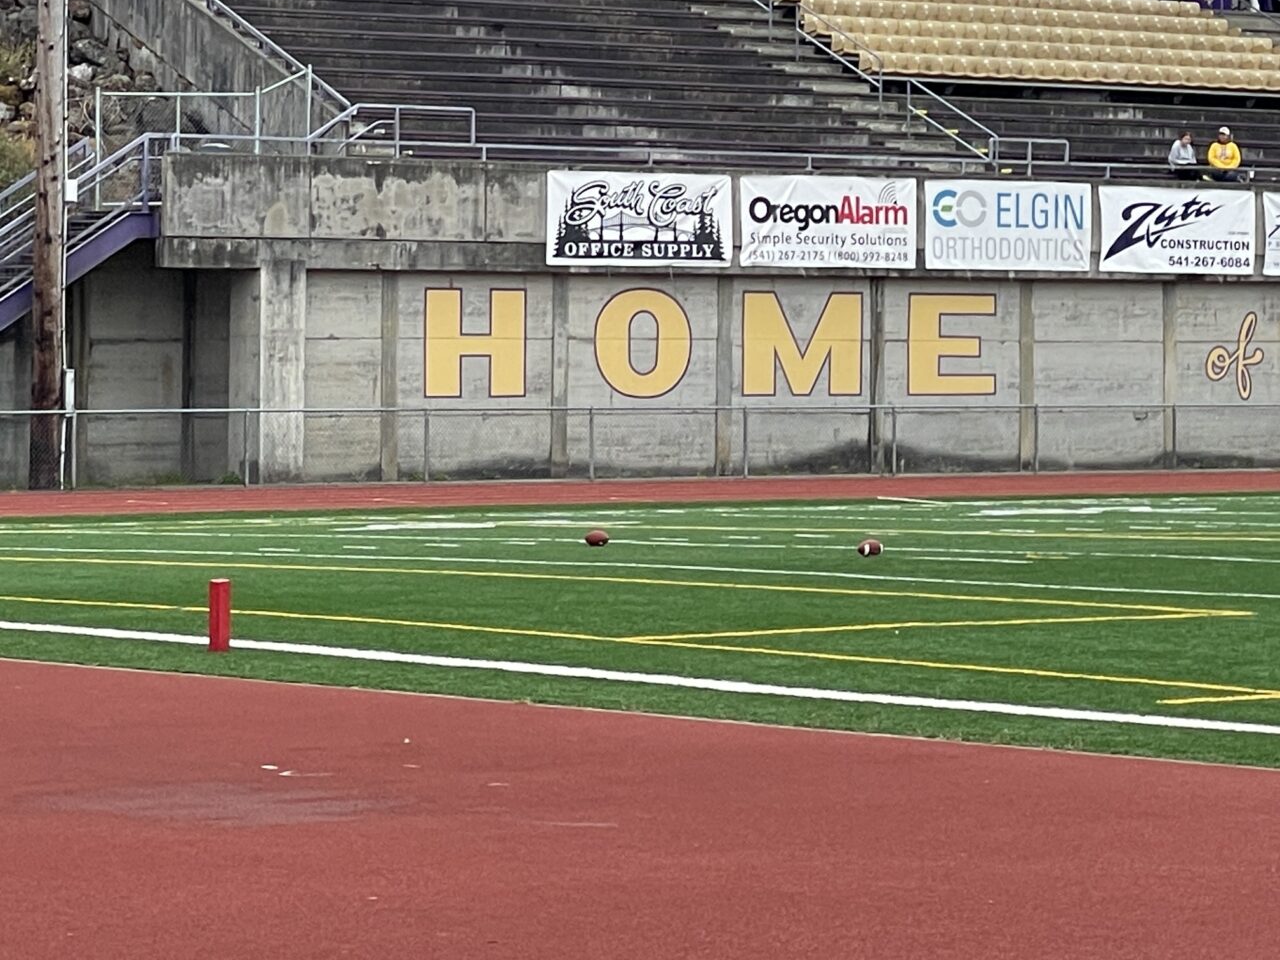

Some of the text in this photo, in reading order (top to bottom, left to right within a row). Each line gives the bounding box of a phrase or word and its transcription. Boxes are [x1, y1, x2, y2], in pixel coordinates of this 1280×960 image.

[565, 179, 720, 228] South Coast
[749, 195, 908, 232] OregonAlarm
[996, 192, 1084, 231] ELGIN
[564, 242, 714, 258] OFFICE SUPPLY
[750, 231, 908, 249] Simple Security Solutions
[932, 236, 1085, 262] ORTHODONTICS
[1160, 237, 1251, 252] CONSTRUCTION
[778, 250, 825, 262] 267-2175
[834, 251, 860, 262] (800)
[1168, 256, 1251, 268] 541-267-6084
[423, 286, 997, 399] HOME
[1205, 310, 1265, 401] of
